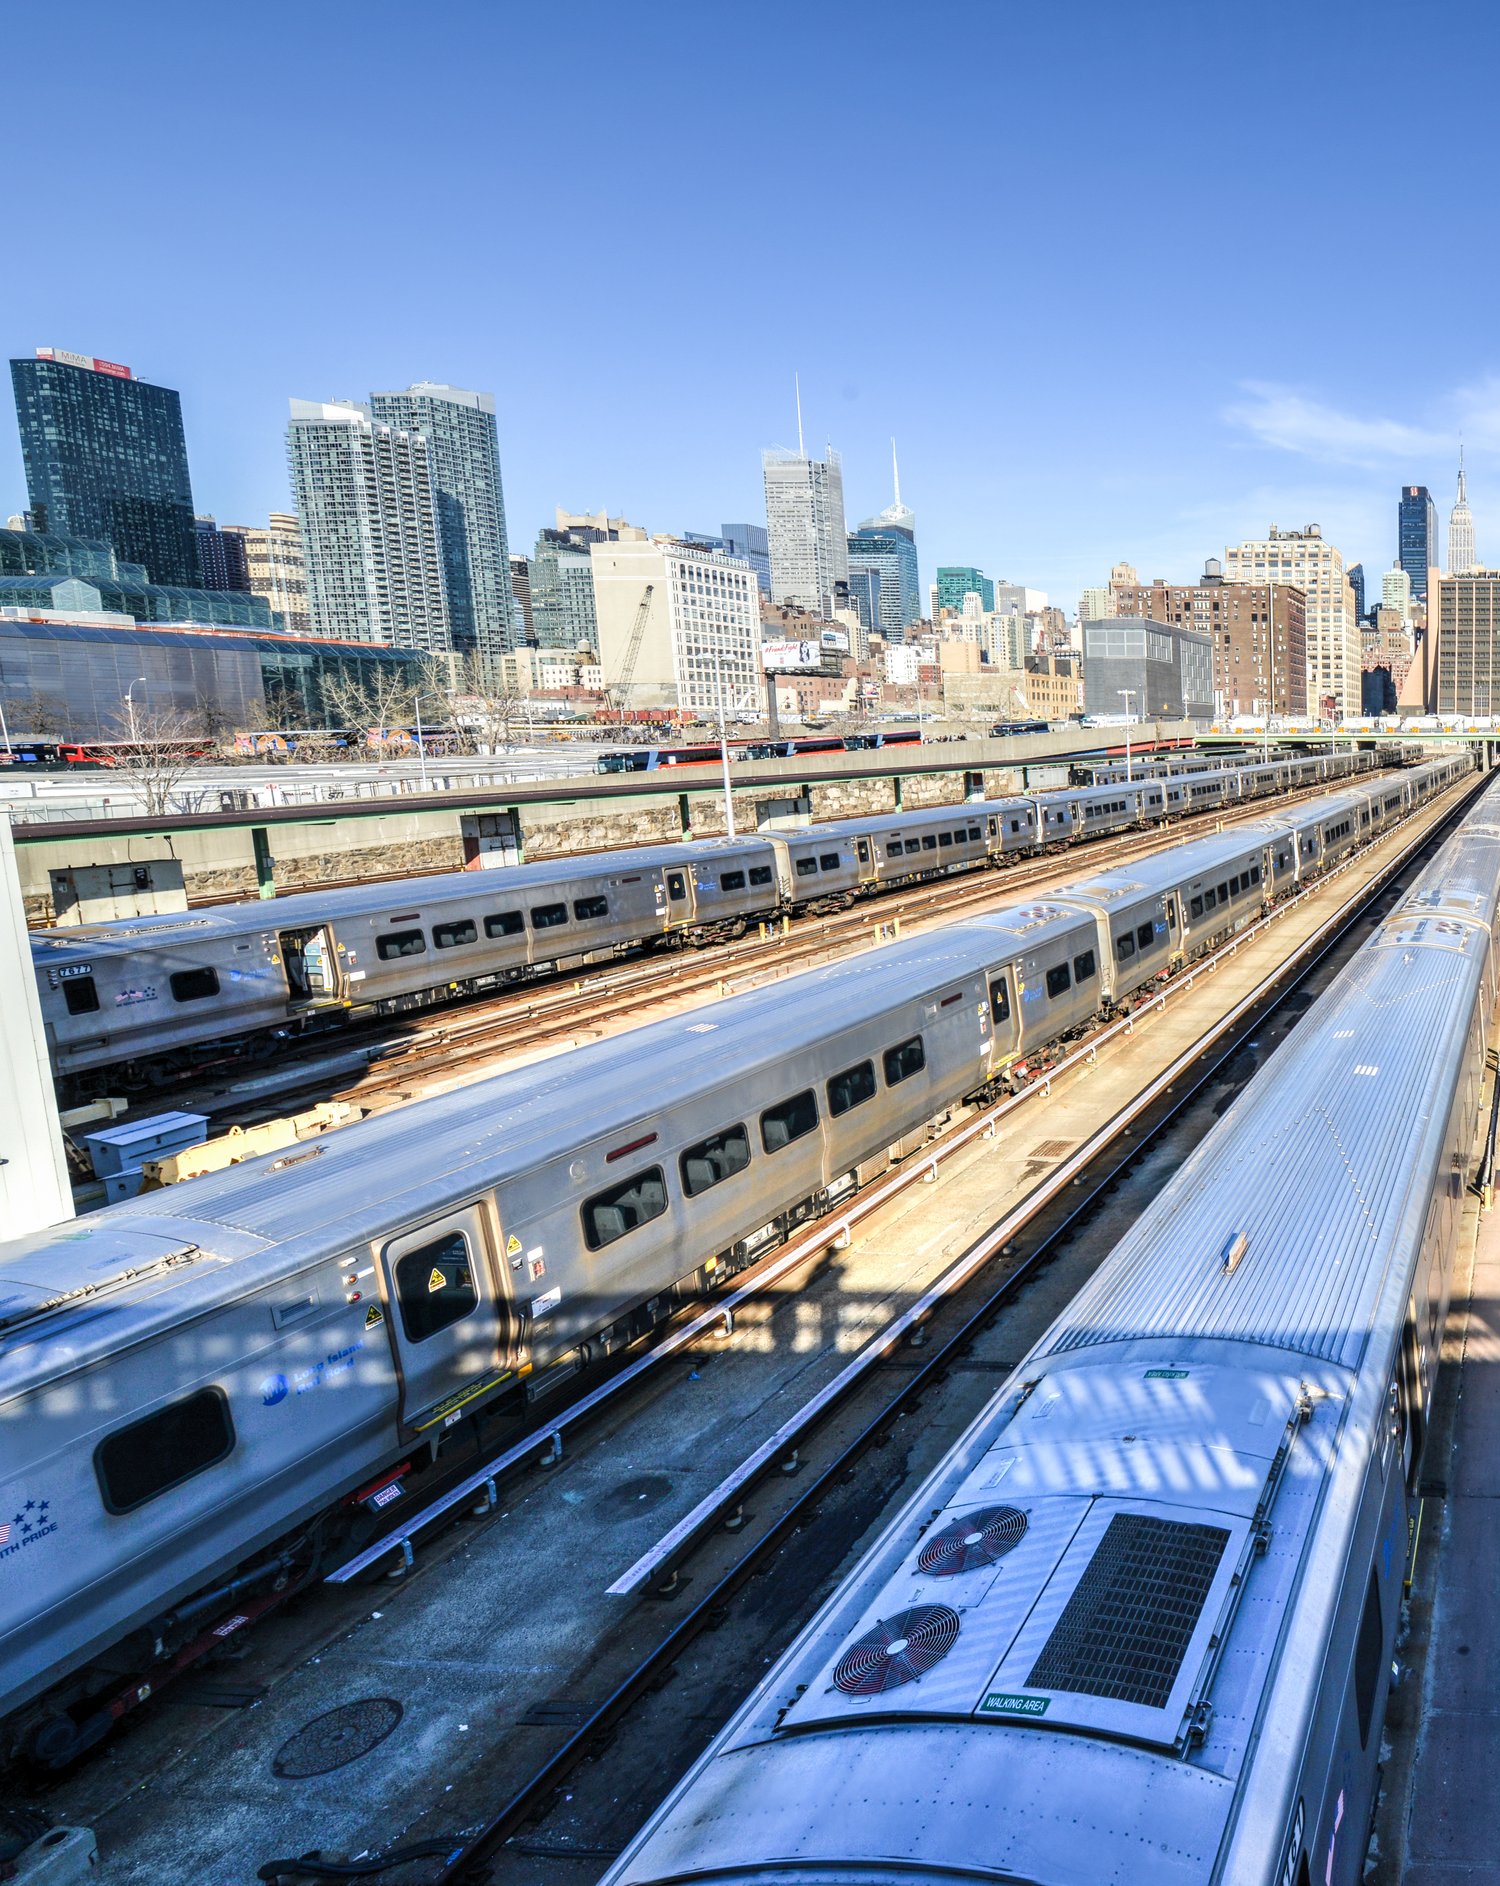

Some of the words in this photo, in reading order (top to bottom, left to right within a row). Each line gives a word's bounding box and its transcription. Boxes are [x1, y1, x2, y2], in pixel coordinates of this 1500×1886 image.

[61, 965, 90, 976] 7677
[375, 1485, 397, 1502] DANGER
[0, 1543, 20, 1559] ITH
[22, 1522, 59, 1546] PRIDE
[986, 1697, 1023, 1709] WALKING
[1021, 1700, 1045, 1711] AREA
